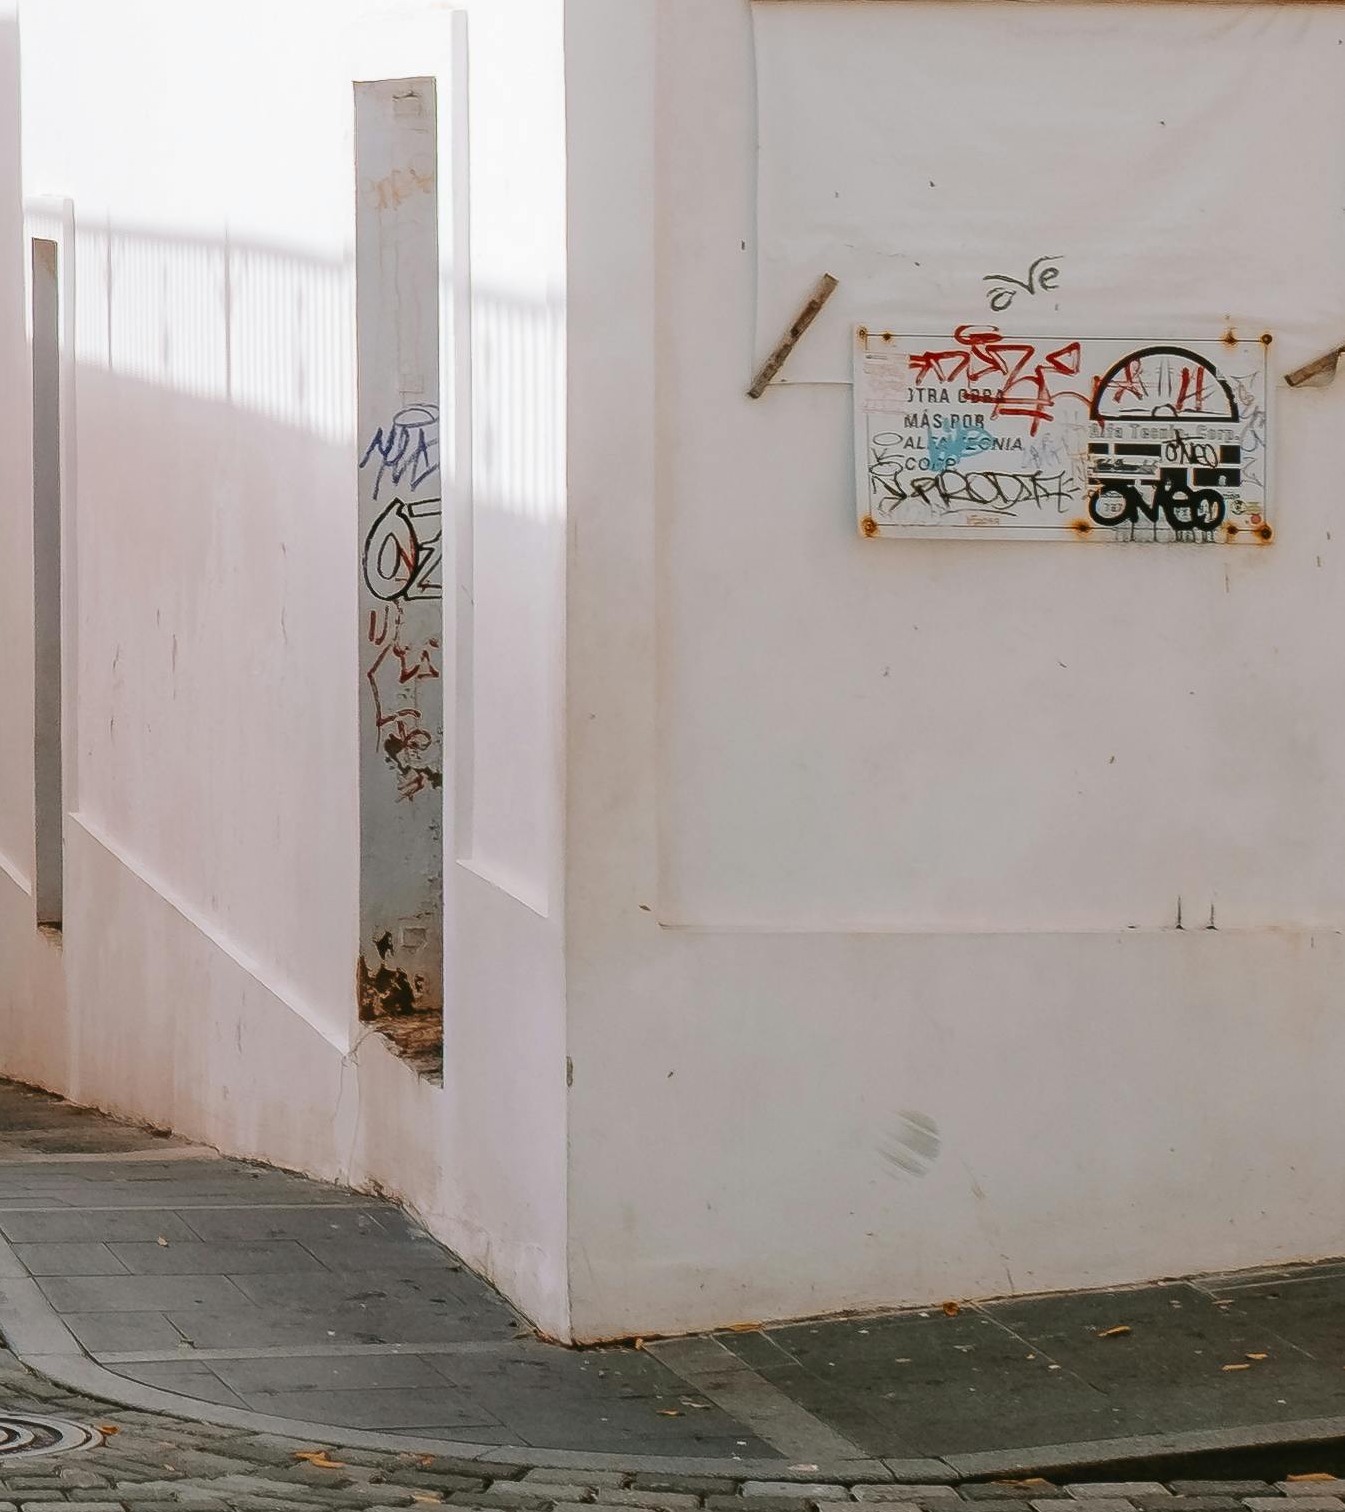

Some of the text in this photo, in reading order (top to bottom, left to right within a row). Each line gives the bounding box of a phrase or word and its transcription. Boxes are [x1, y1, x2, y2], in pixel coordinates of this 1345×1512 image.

[904, 409, 985, 429] MÁS POR
[954, 437, 1023, 451] ECNIA
